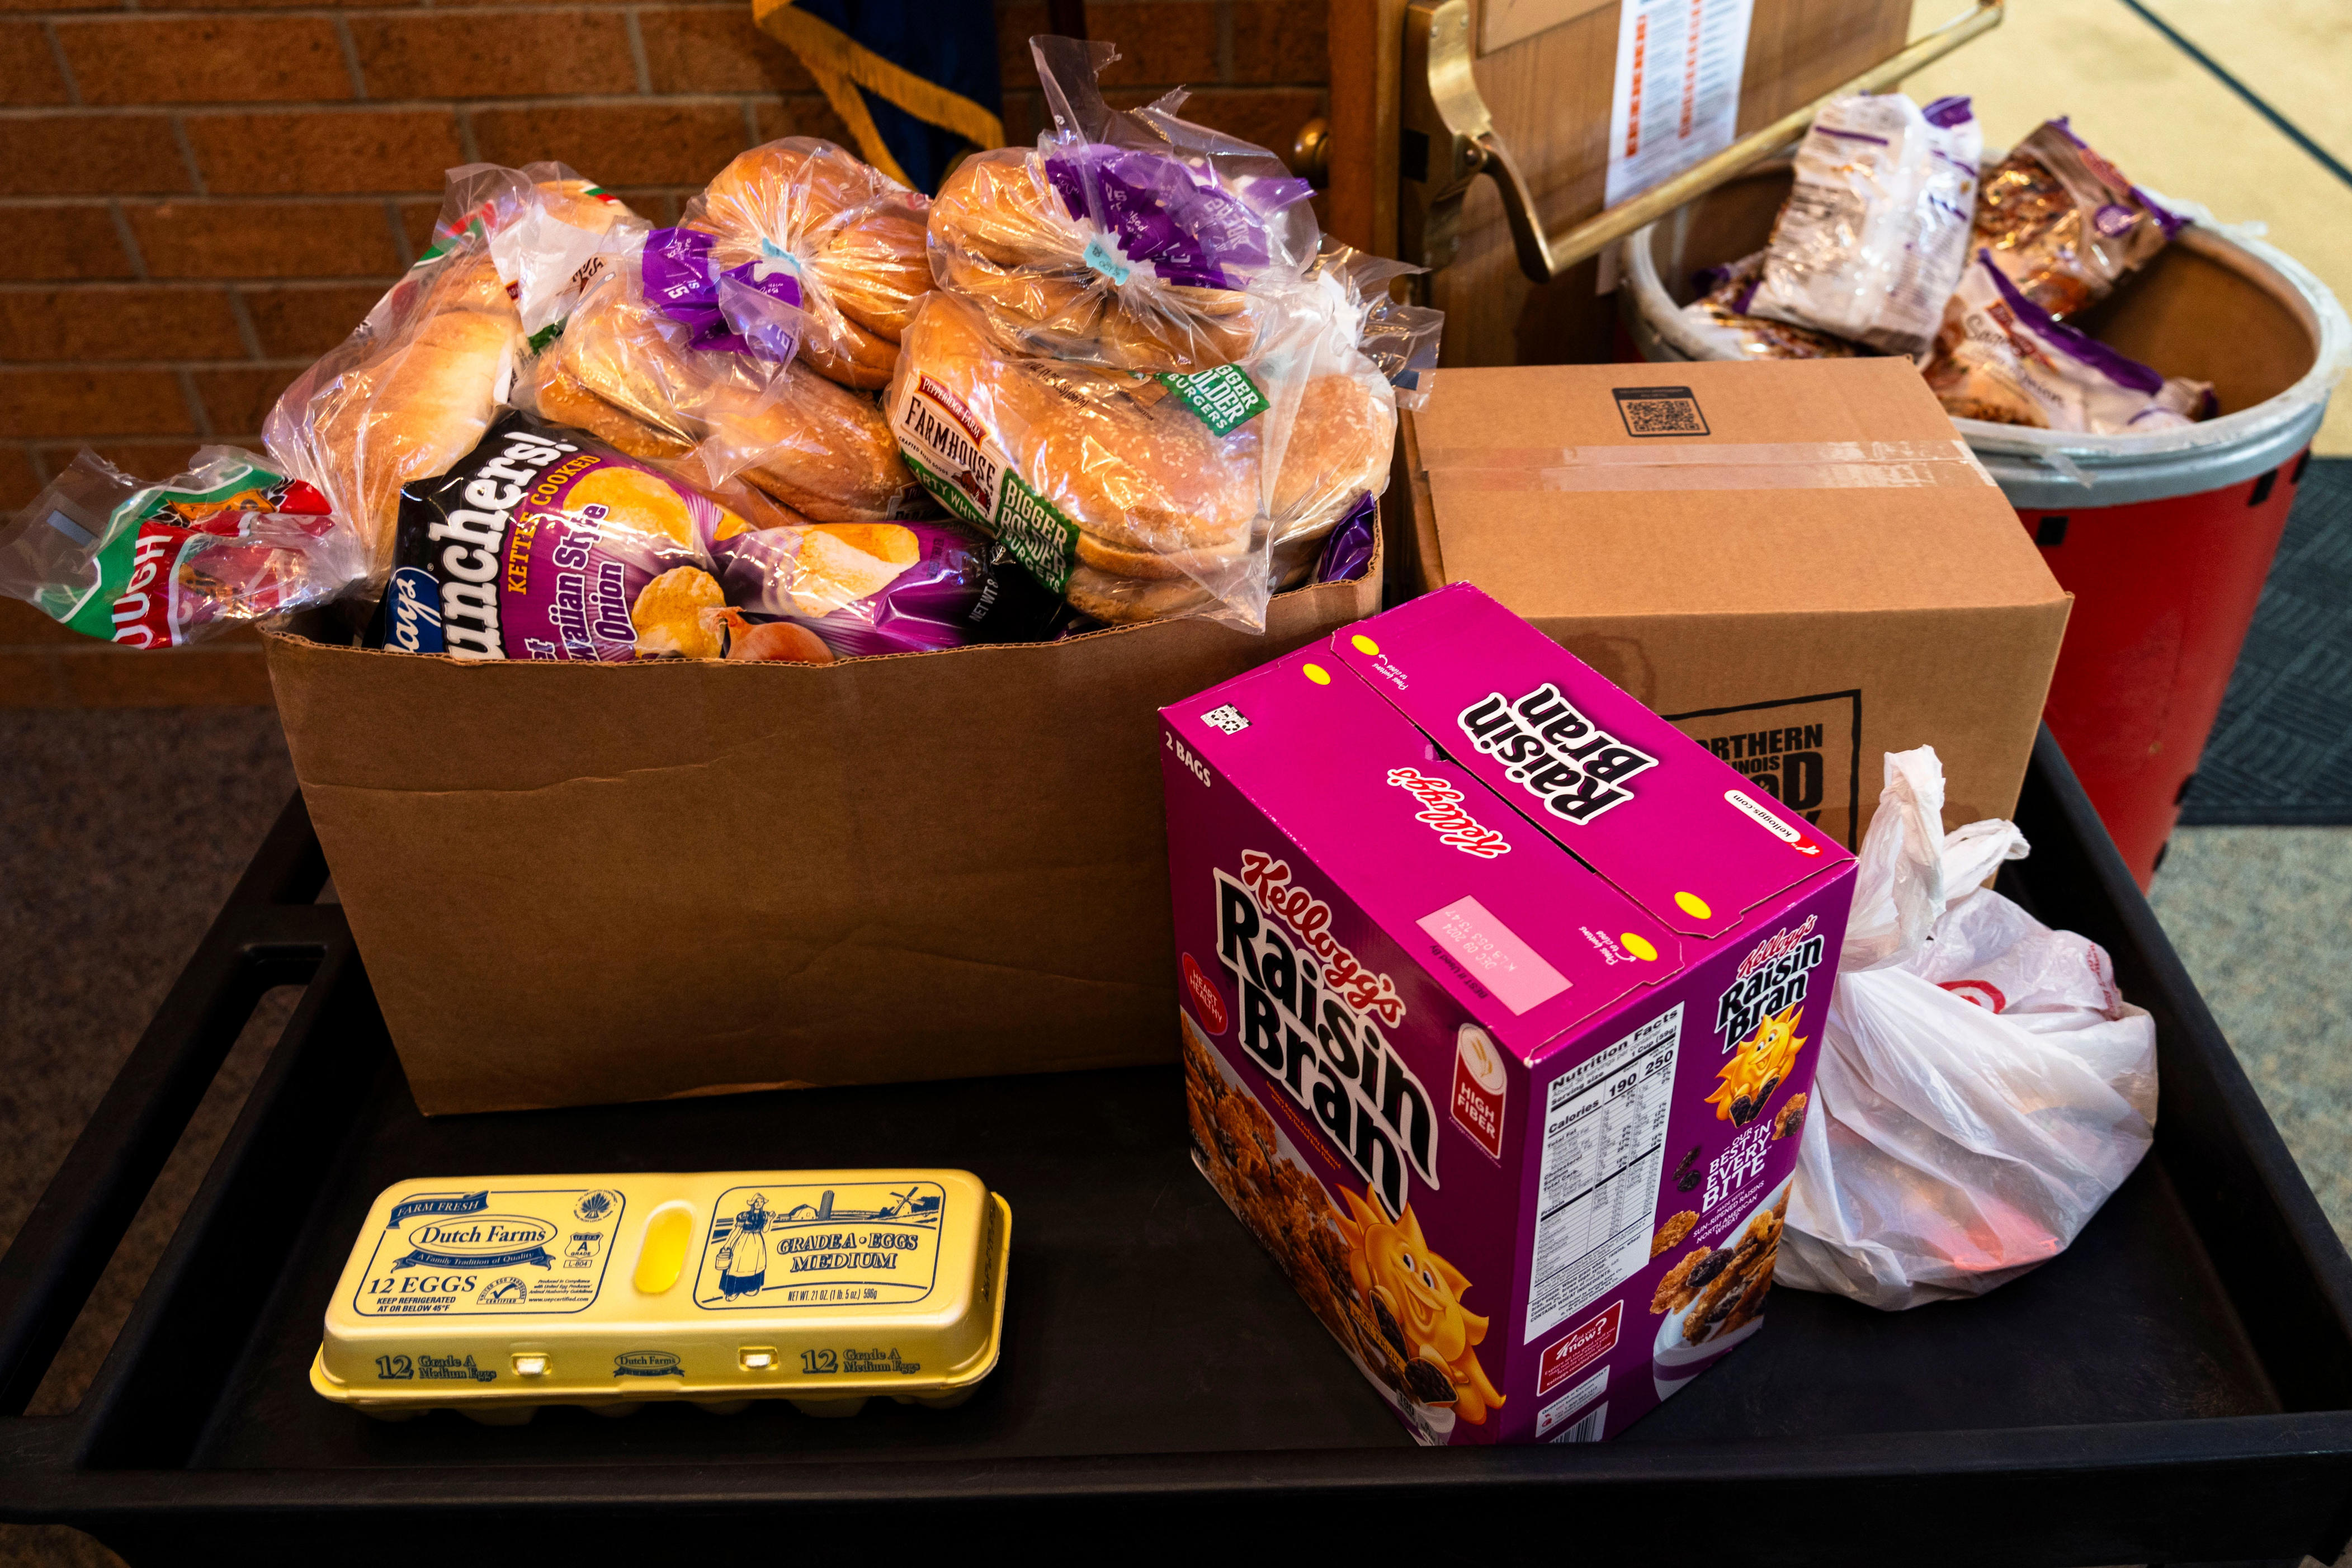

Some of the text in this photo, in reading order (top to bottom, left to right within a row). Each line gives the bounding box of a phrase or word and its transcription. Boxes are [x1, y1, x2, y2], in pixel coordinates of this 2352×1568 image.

[923, 378, 980, 438] PEPPERIDGE FARM
[1167, 374, 1228, 429] BURGERS
[899, 436, 919, 452] CRAFTED
[905, 396, 996, 491] FARMHOUSE
[530, 454, 602, 506] COOKED
[1005, 479, 1068, 555] BIGGER
[1005, 532, 1060, 593] BURGERS
[385, 577, 441, 653] ays
[589, 561, 637, 644] Onion
[968, 601, 989, 622] NET
[980, 585, 999, 604] WT
[1513, 683, 1657, 782] Bran
[1165, 731, 1211, 787] 2 BAGS
[1458, 693, 1633, 824] Raisin
[1388, 768, 1510, 858] Kellogg's
[1734, 794, 1793, 837] kelloggs.com
[1241, 849, 1405, 1028] Kellogg's
[1427, 943, 1444, 956] By
[1440, 922, 1467, 942] 2024
[1461, 941, 1480, 953] 09
[1737, 914, 1817, 980] Kellogg's
[1437, 954, 1462, 974] Used
[1190, 975, 1222, 1023] HEALTHY
[1193, 969, 1217, 1007] HEART
[1463, 978, 1489, 999] BEST
[1715, 934, 1824, 1033] Raisin
[1214, 868, 1439, 1190] Raisin
[1722, 971, 1808, 1054] Bran
[1552, 1007, 1678, 1092] Nutrition Facts
[1637, 1038, 1653, 1054] Cup
[1656, 1024, 1676, 1043] (59g)
[1552, 1081, 1573, 1099] About
[1585, 1056, 1615, 1080] servings
[1617, 1048, 1627, 1061] per
[1630, 1027, 1661, 1051] container
[1644, 1047, 1674, 1076] 250
[1239, 971, 1408, 1221] Bran
[1461, 1082, 1495, 1123] HIGH
[1551, 1069, 1604, 1107] Serving size
[1608, 1070, 1637, 1099] 190
[1457, 1094, 1496, 1139] FIBER
[1548, 1095, 1599, 1135] Calories
[1547, 1127, 1576, 1149] Total Fat
[1709, 1119, 1772, 1174] BEST IN
[1732, 1127, 1752, 1145] OUR
[1543, 1167, 1579, 1193] Total Carb.
[1544, 1153, 1582, 1181] Cholesterol
[1707, 1132, 1771, 1190] EVERY
[1702, 1149, 1767, 1213] BITE
[397, 1200, 479, 1216] FARM FRESH
[1541, 1198, 1565, 1217] Protein
[1693, 1180, 1764, 1238] SUN-RIPENED RAISINS
[1697, 1194, 1758, 1244] NORTH AMERICAN
[1716, 1189, 1745, 1213] MADE WITH
[419, 1225, 546, 1243] Dutch Farms
[1716, 1212, 1740, 1235] WHEAT
[426, 1255, 451, 1265] Family
[503, 1252, 534, 1262] Quality
[578, 1241, 588, 1251] A
[777, 1232, 918, 1255] GRADE A EGGS
[790, 1253, 898, 1273] MEDIUM
[1532, 1234, 1640, 1308] Ingredients: Whole grain wheat
[368, 1275, 477, 1294] 12 EGGS
[479, 1283, 493, 1301] UNITED
[788, 1290, 799, 1301] NET
[800, 1290, 809, 1301] WT.
[811, 1290, 818, 1300] 21
[820, 1290, 828, 1300] OZ.
[846, 1289, 849, 1300] 5
[851, 1288, 861, 1300] oz.)
[1530, 1291, 1575, 1323] CONTAINS WHEAT
[1555, 1314, 1607, 1363] Know?
[1574, 1325, 1595, 1343] did you
[375, 1354, 477, 1380] 12 Grade A
[418, 1366, 497, 1382] Medium Eggs
[620, 1356, 676, 1366] Dutch Farms
[800, 1348, 901, 1373] 12 Grade A
[843, 1360, 920, 1375] Medium Eggs
